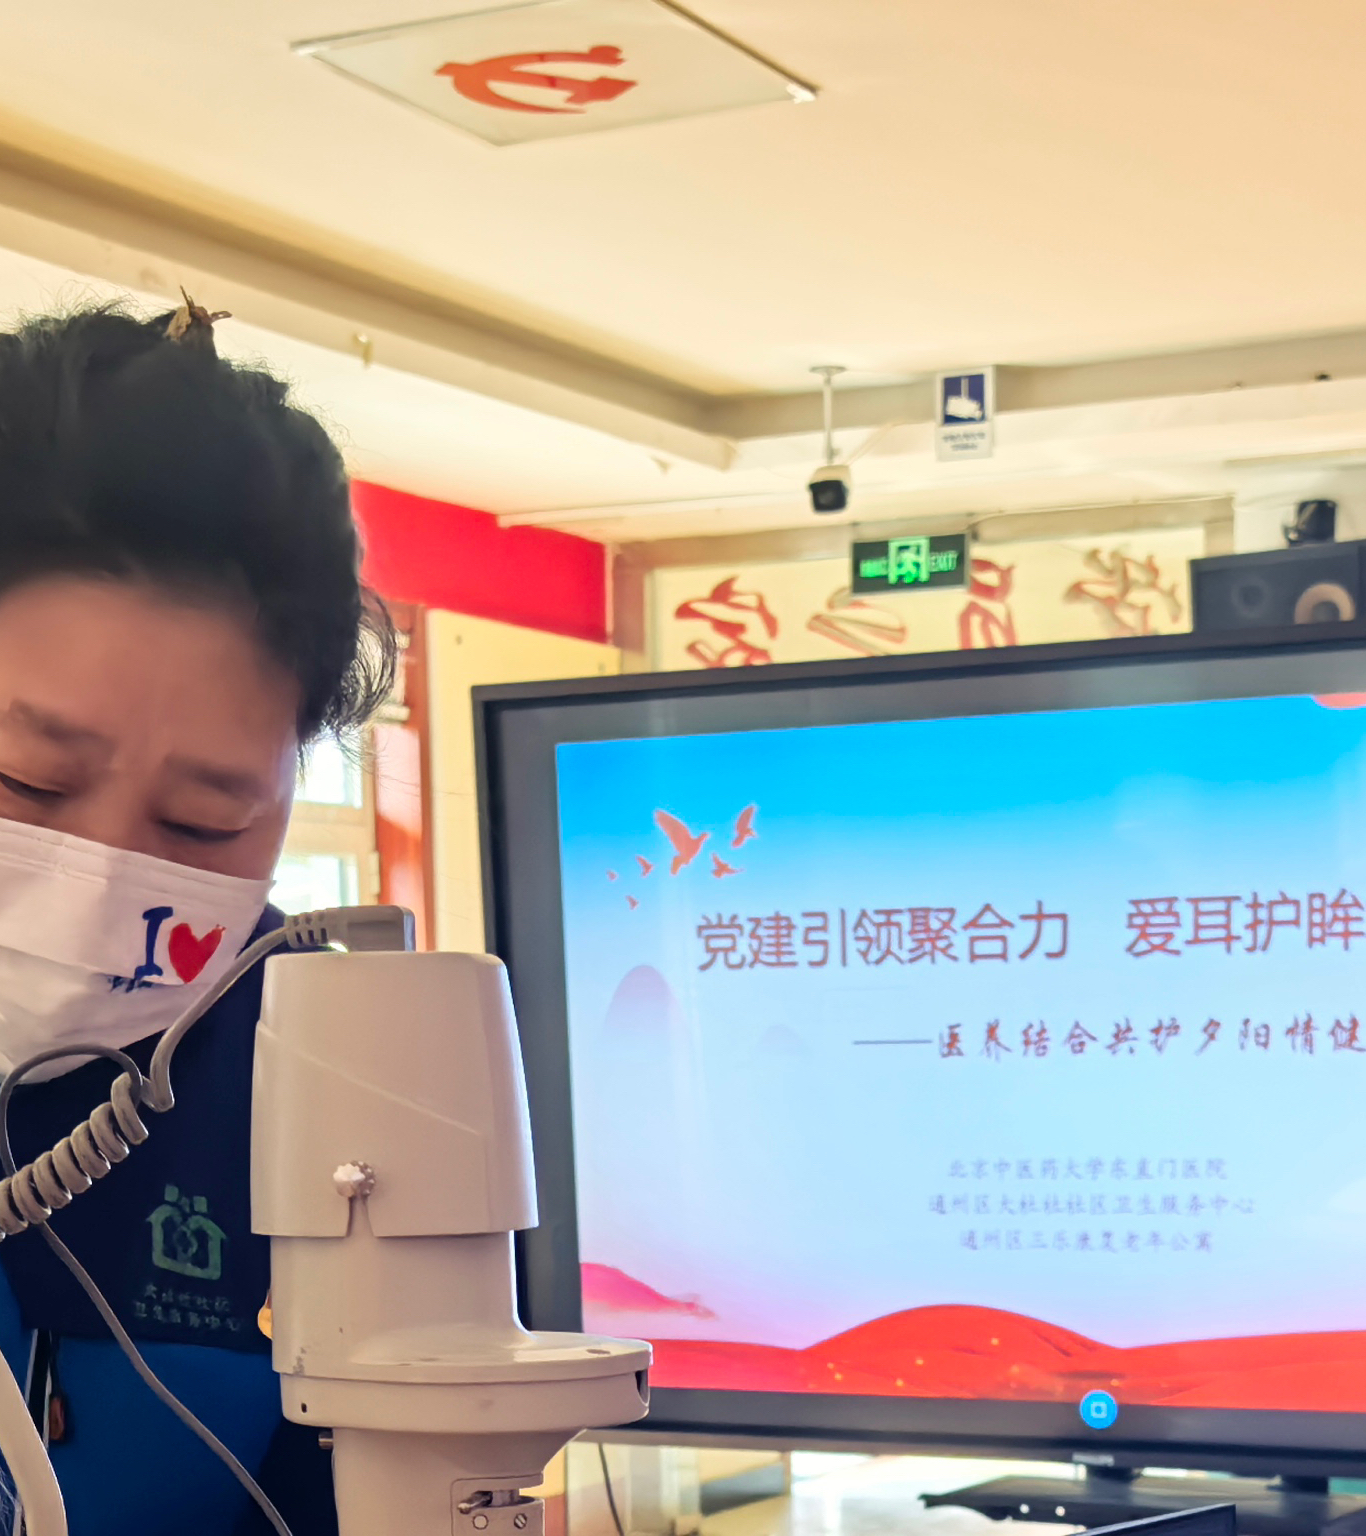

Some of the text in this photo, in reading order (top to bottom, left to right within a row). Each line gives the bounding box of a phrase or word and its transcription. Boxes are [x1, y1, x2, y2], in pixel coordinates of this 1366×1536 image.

[696, 899, 1069, 971] 党建引领聚合力
